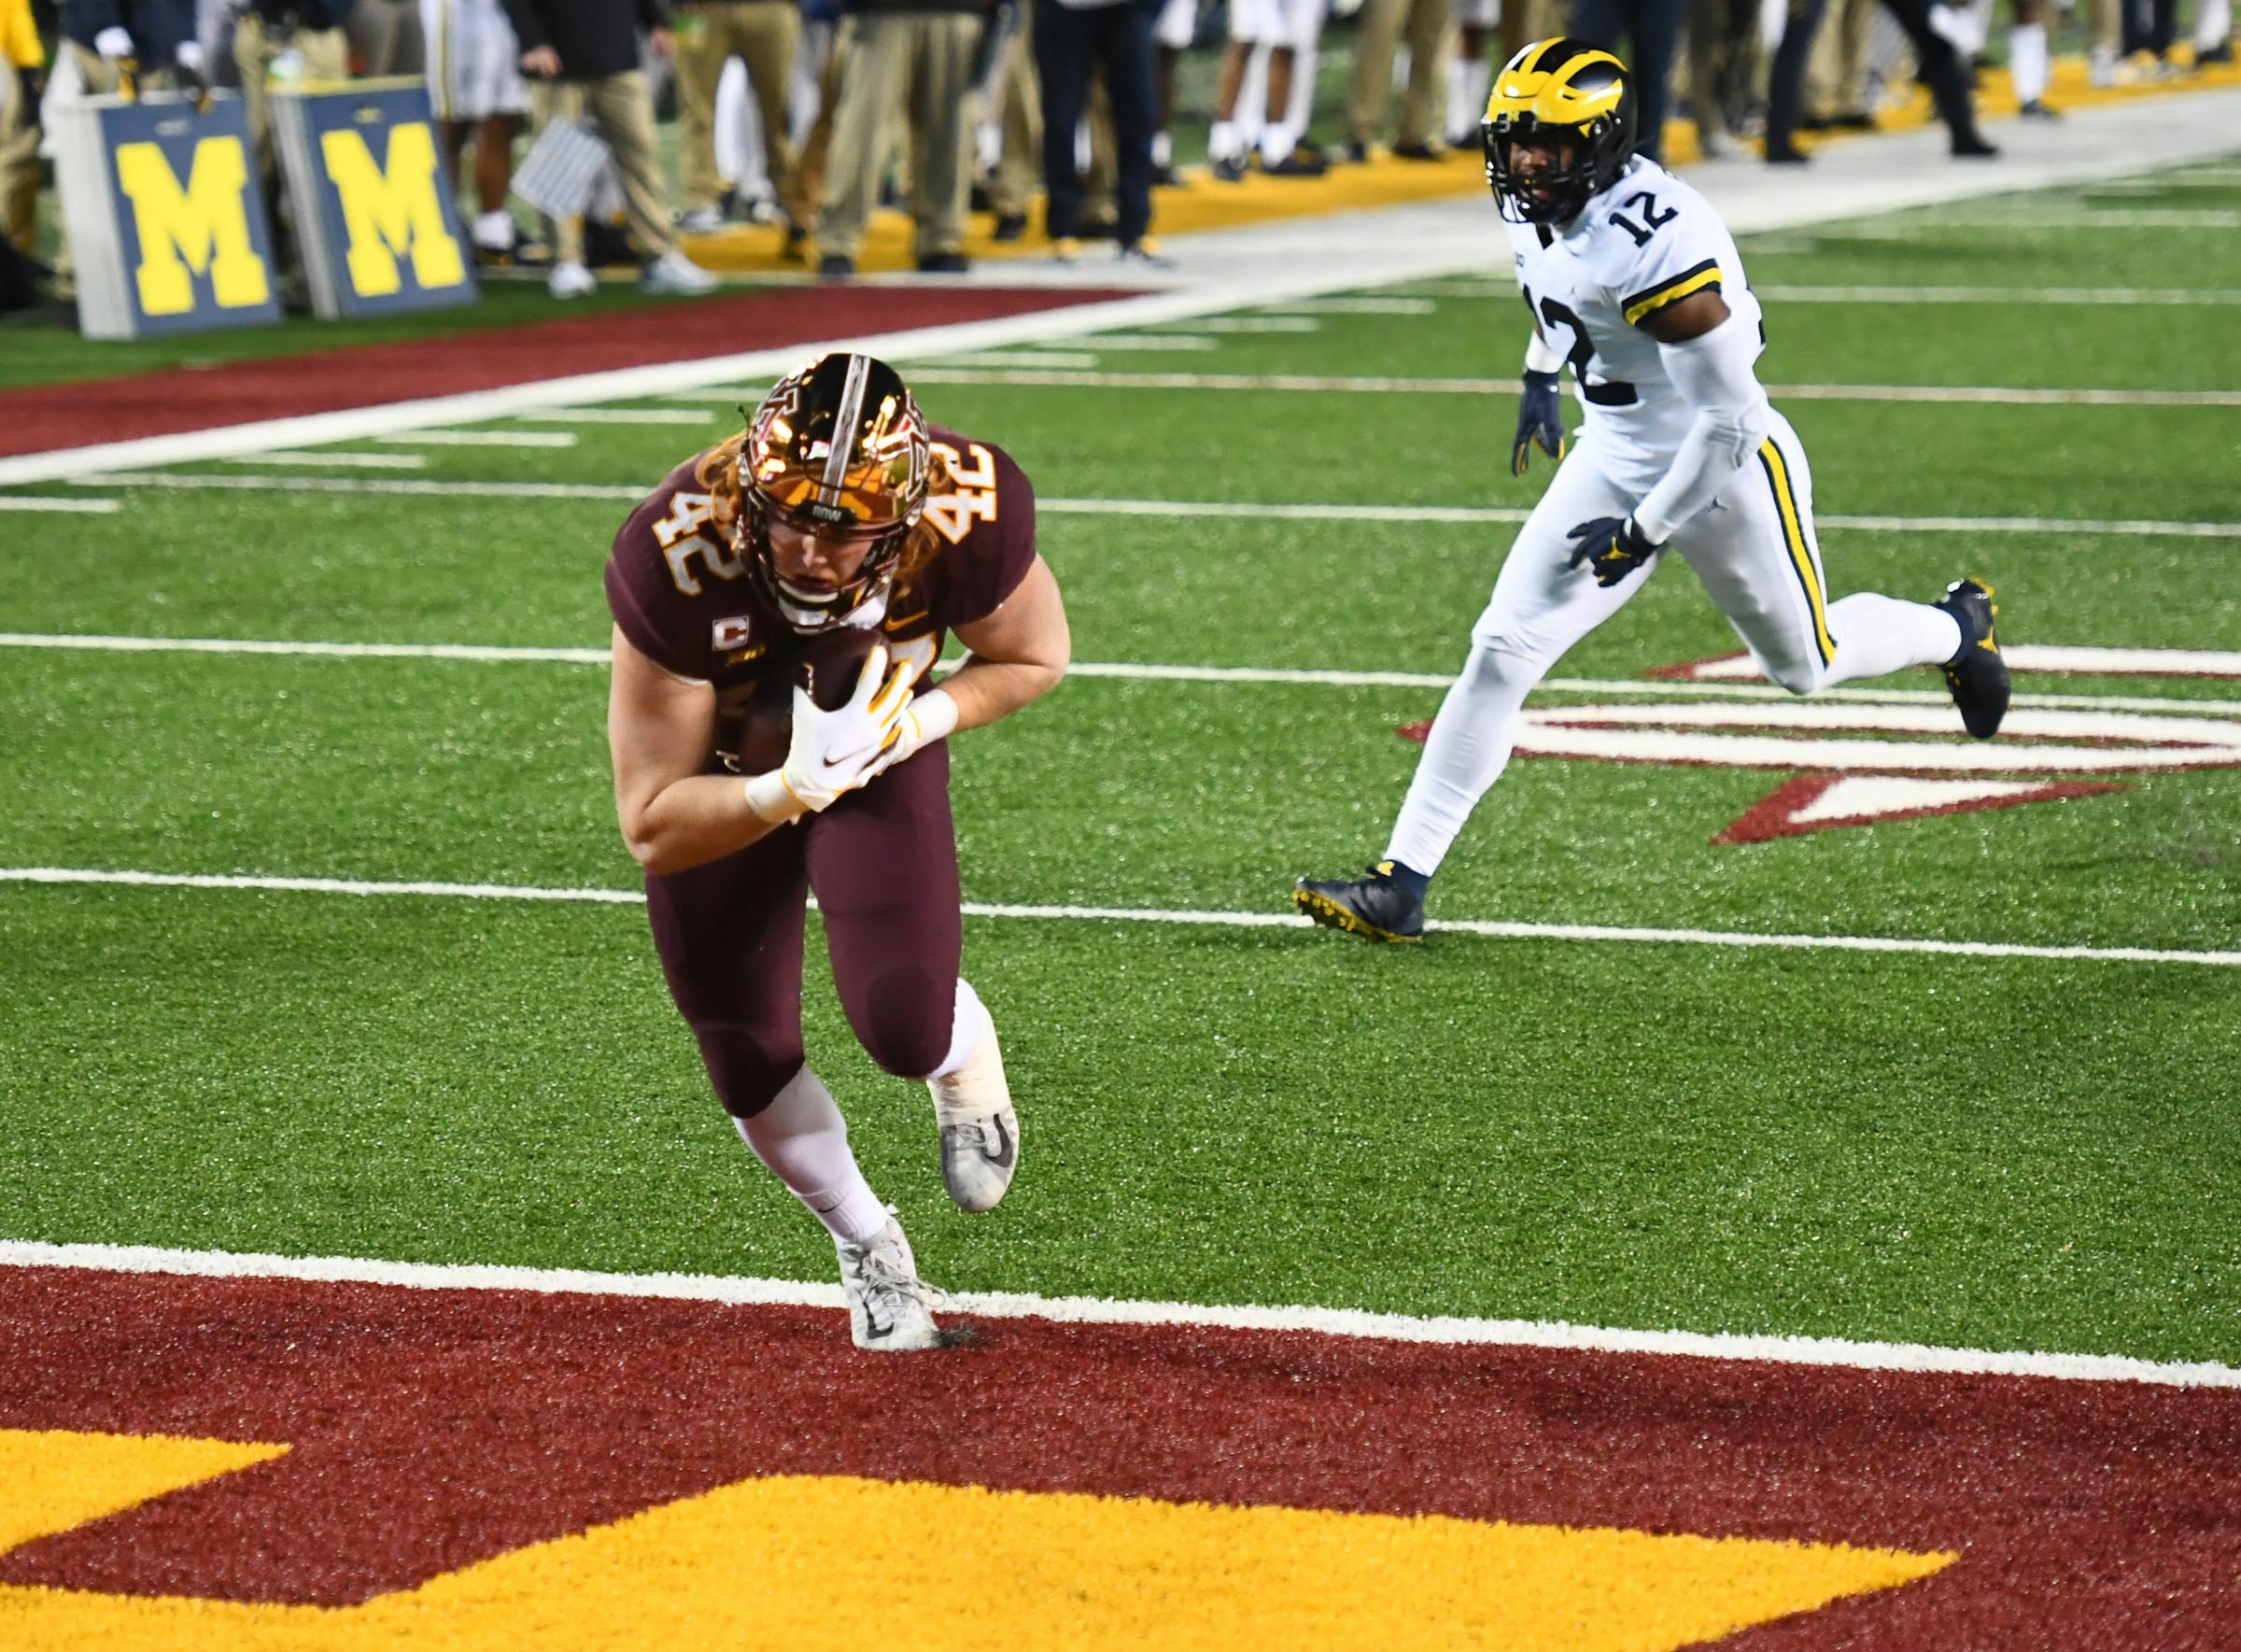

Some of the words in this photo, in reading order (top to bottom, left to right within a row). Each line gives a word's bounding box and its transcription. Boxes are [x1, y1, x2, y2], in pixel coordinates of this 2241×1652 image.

[116, 135, 269, 316] M
[320, 121, 465, 297] M
[1608, 191, 1679, 248] 12
[652, 492, 746, 596] 42
[922, 441, 997, 544] 42
[714, 617, 748, 651] C
